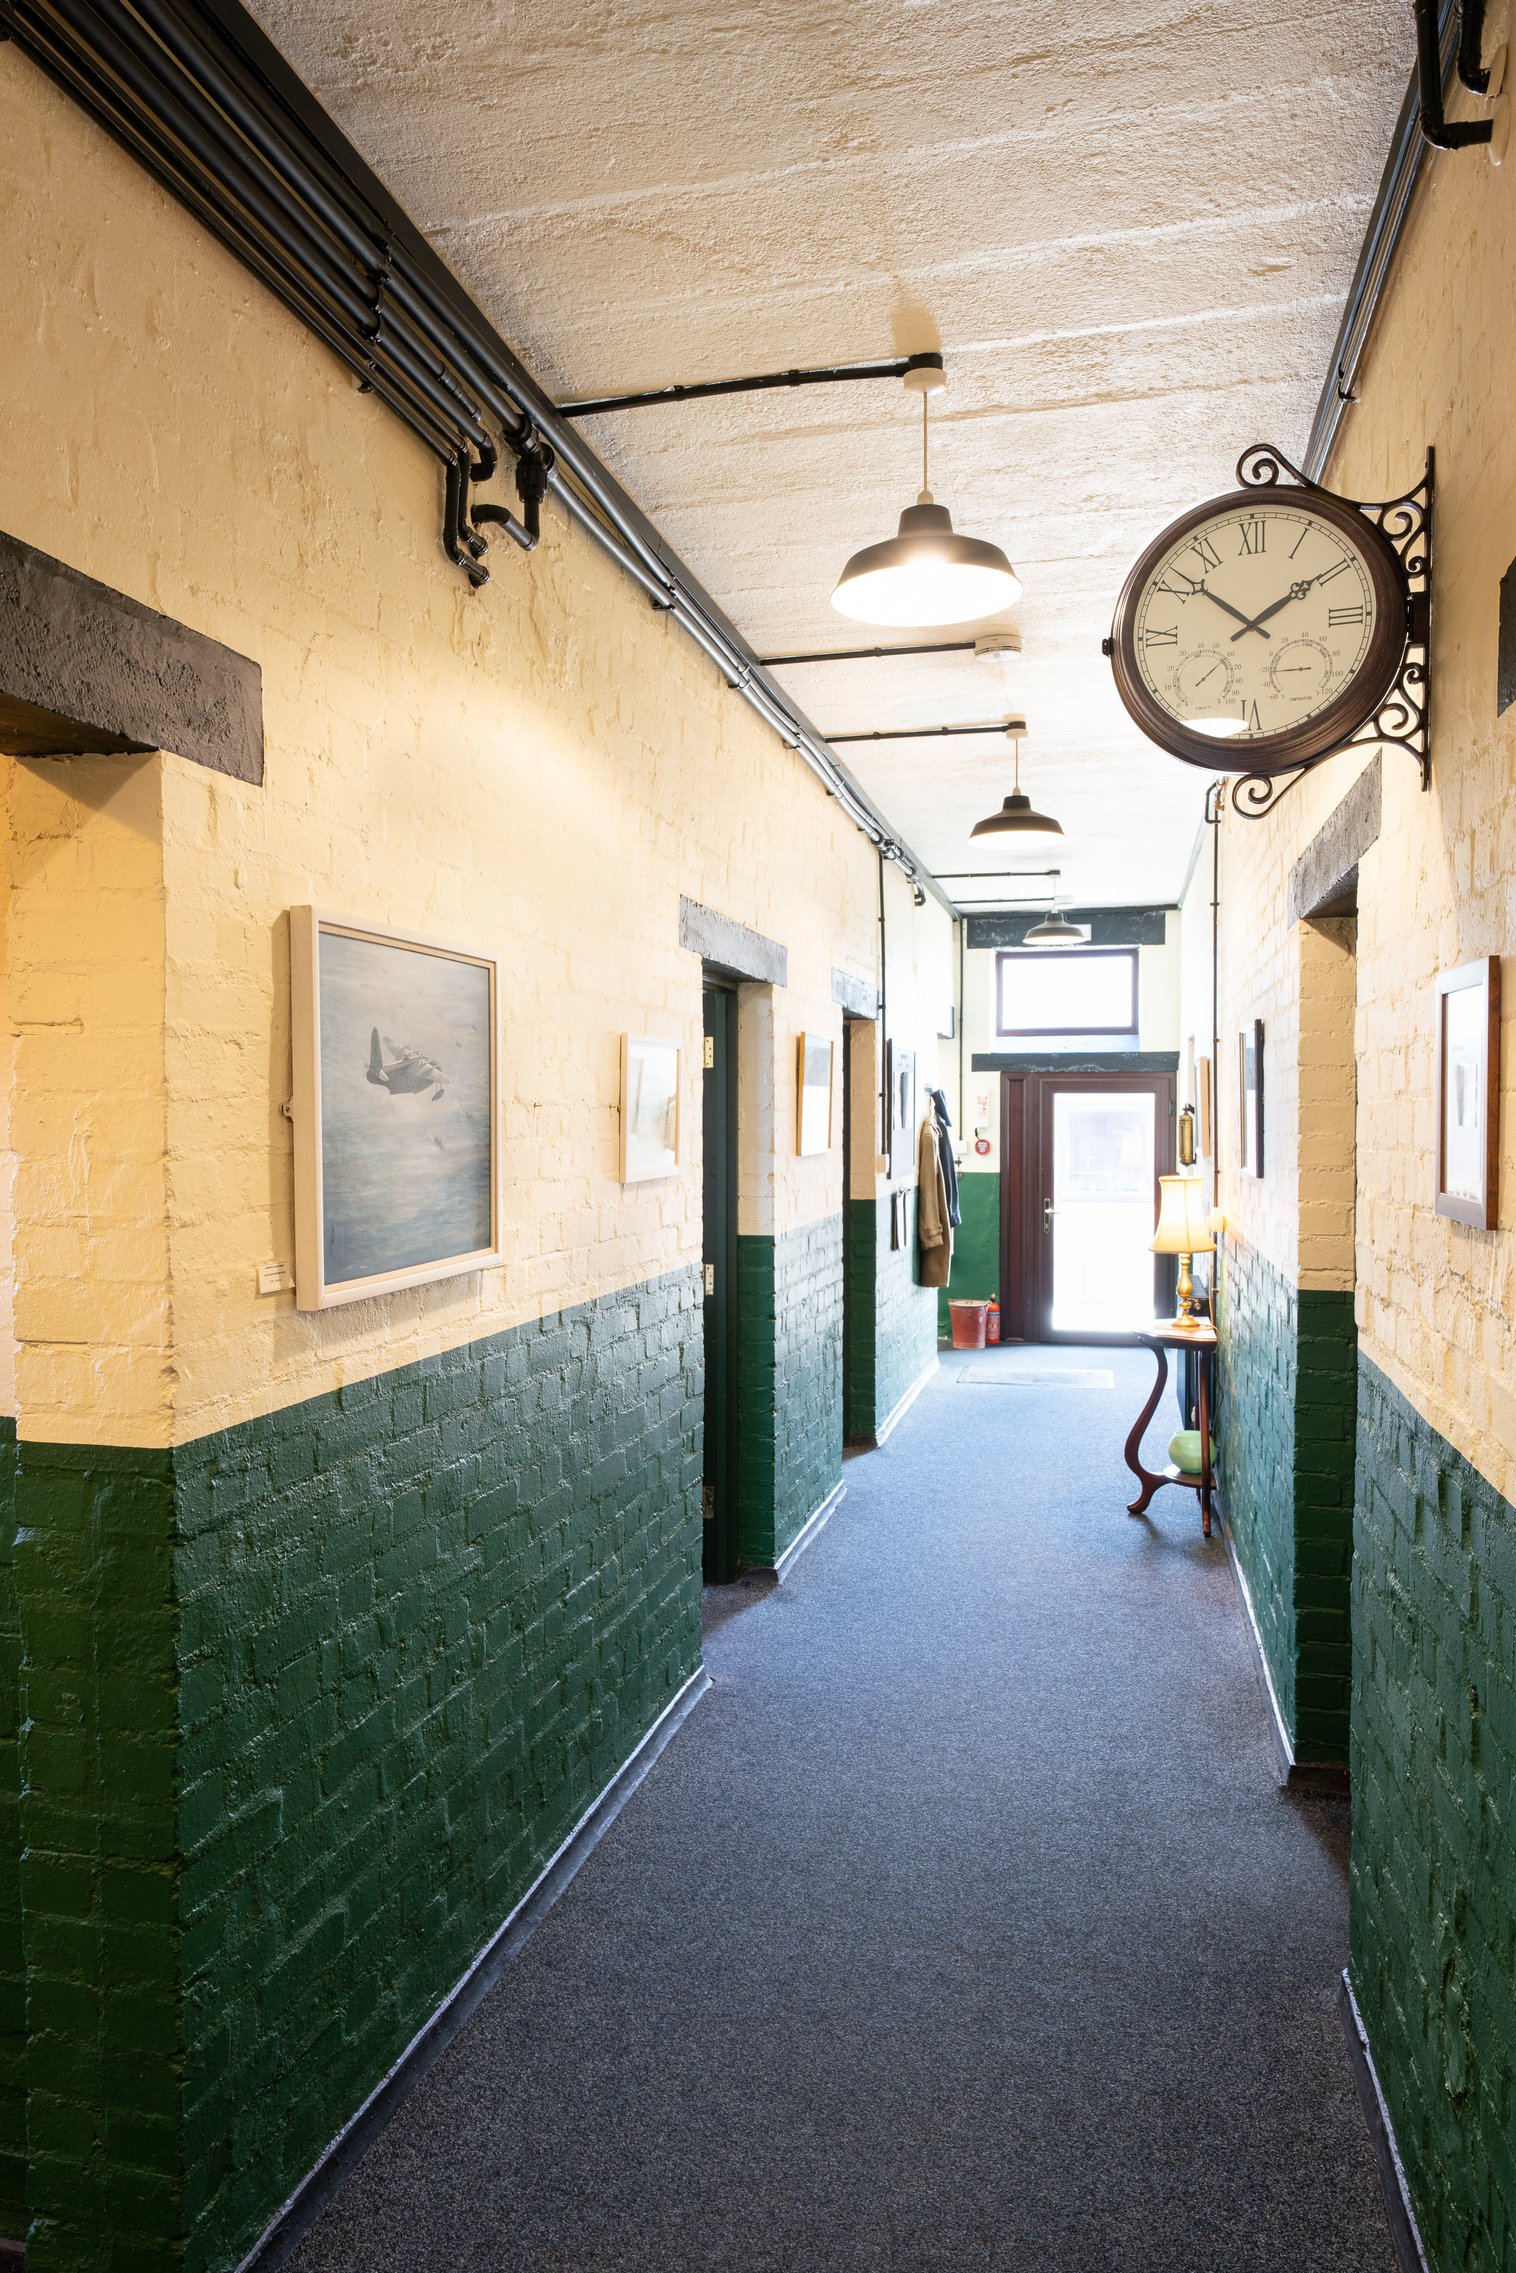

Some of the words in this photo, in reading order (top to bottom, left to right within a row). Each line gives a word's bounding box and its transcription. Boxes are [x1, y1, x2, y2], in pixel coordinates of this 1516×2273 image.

[1238, 520, 1267, 556] XII
[1288, 528, 1310, 560] I
[1190, 537, 1223, 575] XI
[1316, 558, 1351, 587] II
[1157, 579, 1191, 605] X
[1328, 604, 1364, 628] III
[1145, 625, 1178, 648] IX
